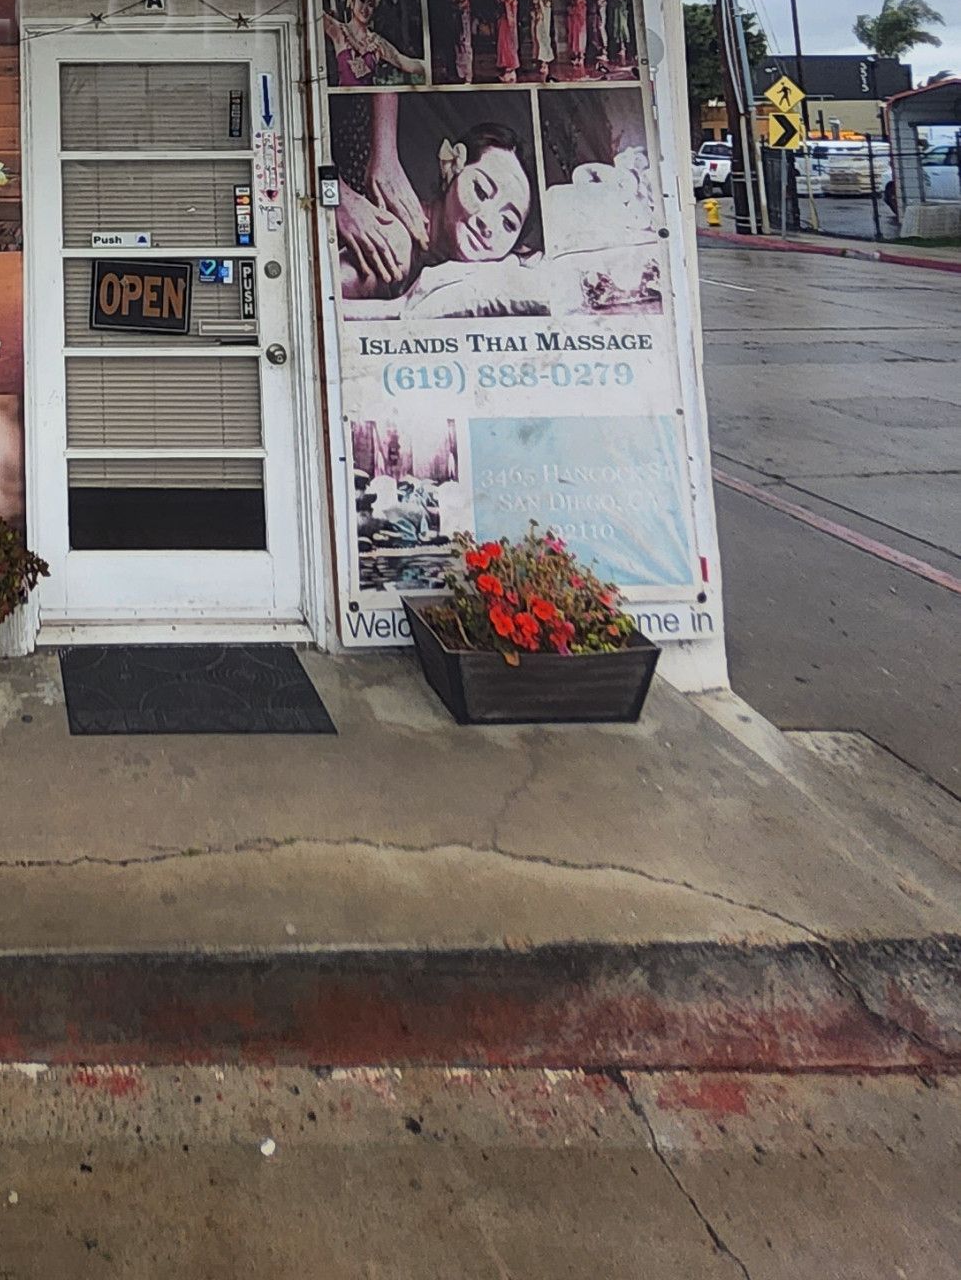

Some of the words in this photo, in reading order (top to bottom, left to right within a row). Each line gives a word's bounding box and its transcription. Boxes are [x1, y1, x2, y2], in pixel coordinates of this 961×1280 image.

[93, 235, 123, 245] Push
[99, 272, 186, 319] OPEN
[243, 266, 254, 315] PUSH
[466, 333, 527, 353] THAI
[383, 361, 466, 396] (619)
[478, 361, 634, 389] 888-0279
[692, 606, 713, 633] in
